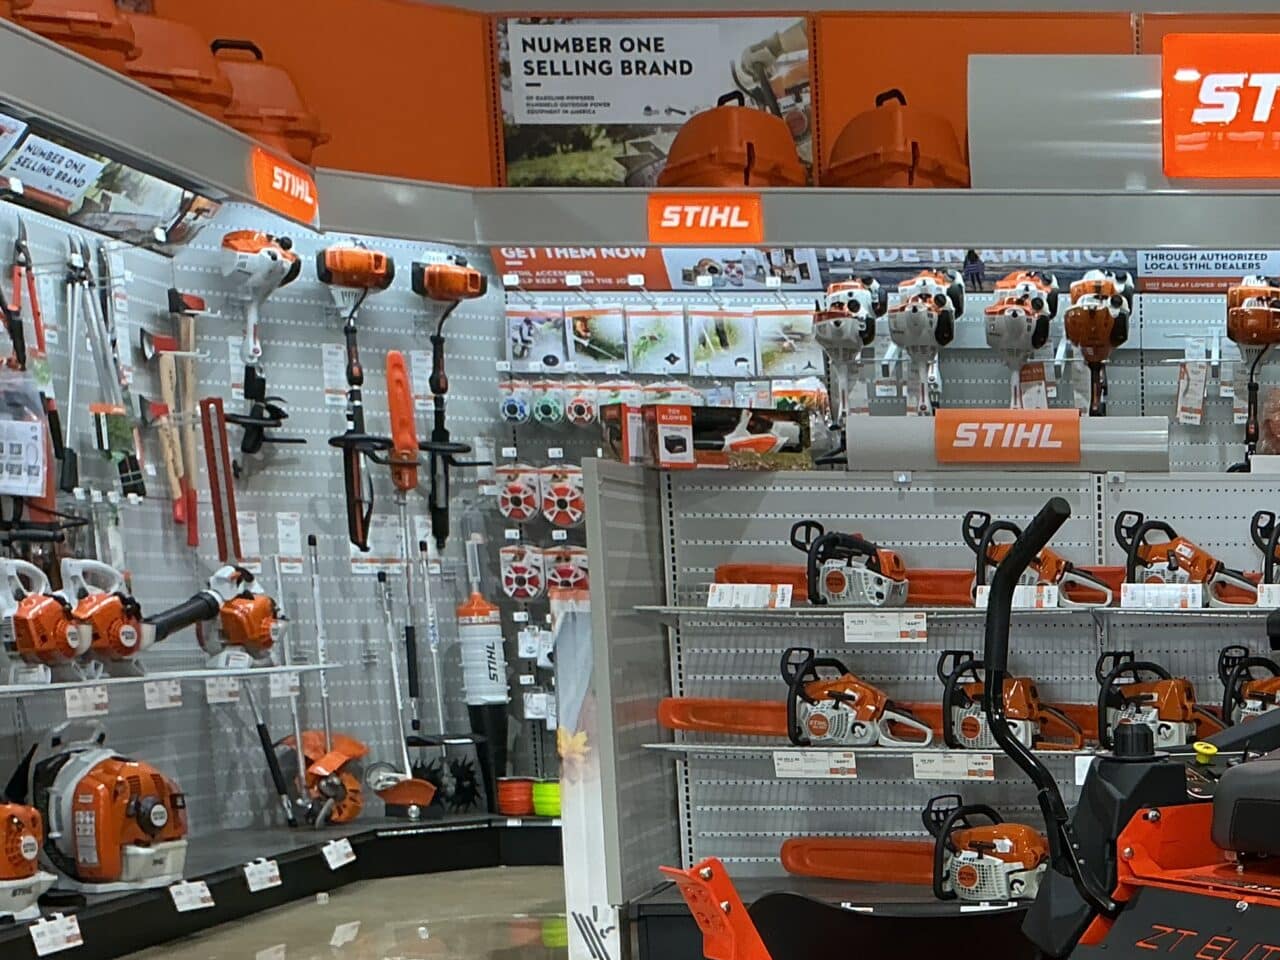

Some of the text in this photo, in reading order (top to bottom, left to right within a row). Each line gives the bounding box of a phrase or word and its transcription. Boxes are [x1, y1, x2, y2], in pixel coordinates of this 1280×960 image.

[521, 37, 665, 53] NUMBER ONE
[523, 59, 693, 75] SELLING BRAND
[25, 143, 87, 174] NUMBER ONE
[15, 155, 86, 188] SELLING BRAND
[272, 166, 315, 205] STIHL
[661, 206, 750, 229] STIHL
[501, 247, 647, 259] GET THEM NOW
[826, 248, 1129, 262] MADE IN AMERICA
[1144, 253, 1268, 261] THROUGH AUTHORIZED
[1144, 262, 1261, 270] LOCAL STIHL DEALERS
[953, 422, 1063, 449] STIHL
[486, 640, 498, 683] STIHL
[1135, 924, 1198, 952] ZT
